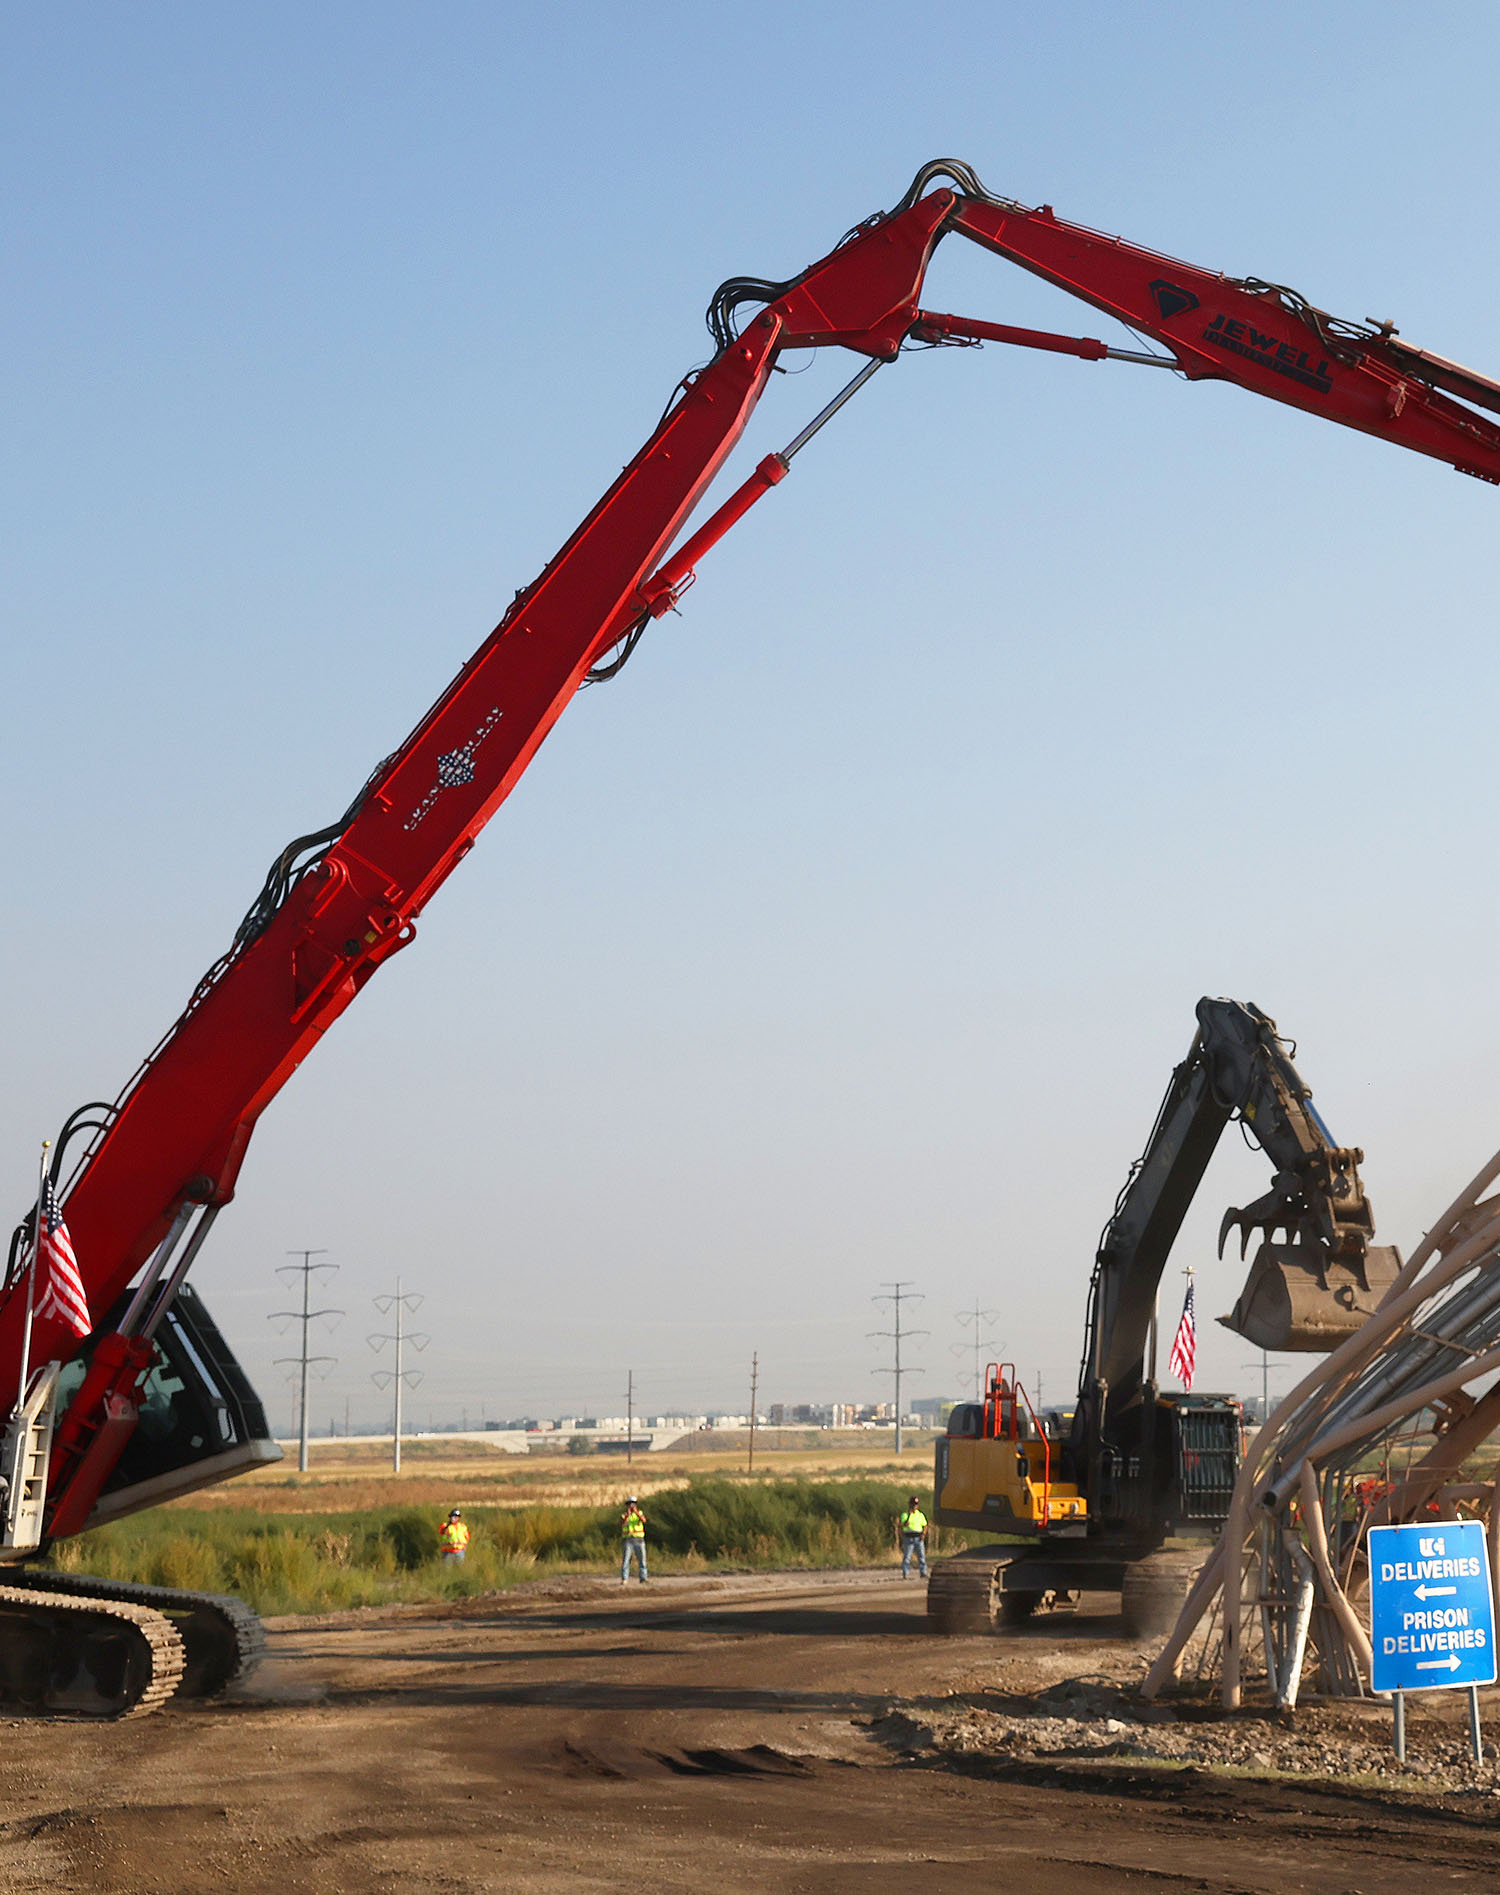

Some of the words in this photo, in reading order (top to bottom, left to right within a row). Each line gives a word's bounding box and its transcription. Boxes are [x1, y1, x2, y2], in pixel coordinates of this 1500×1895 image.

[1208, 313, 1334, 382] JEWELL
[1381, 1557, 1481, 1582] DELIVERIES
[1403, 1607, 1469, 1631] PRISON
[1383, 1628, 1486, 1655] DELIVERIES
